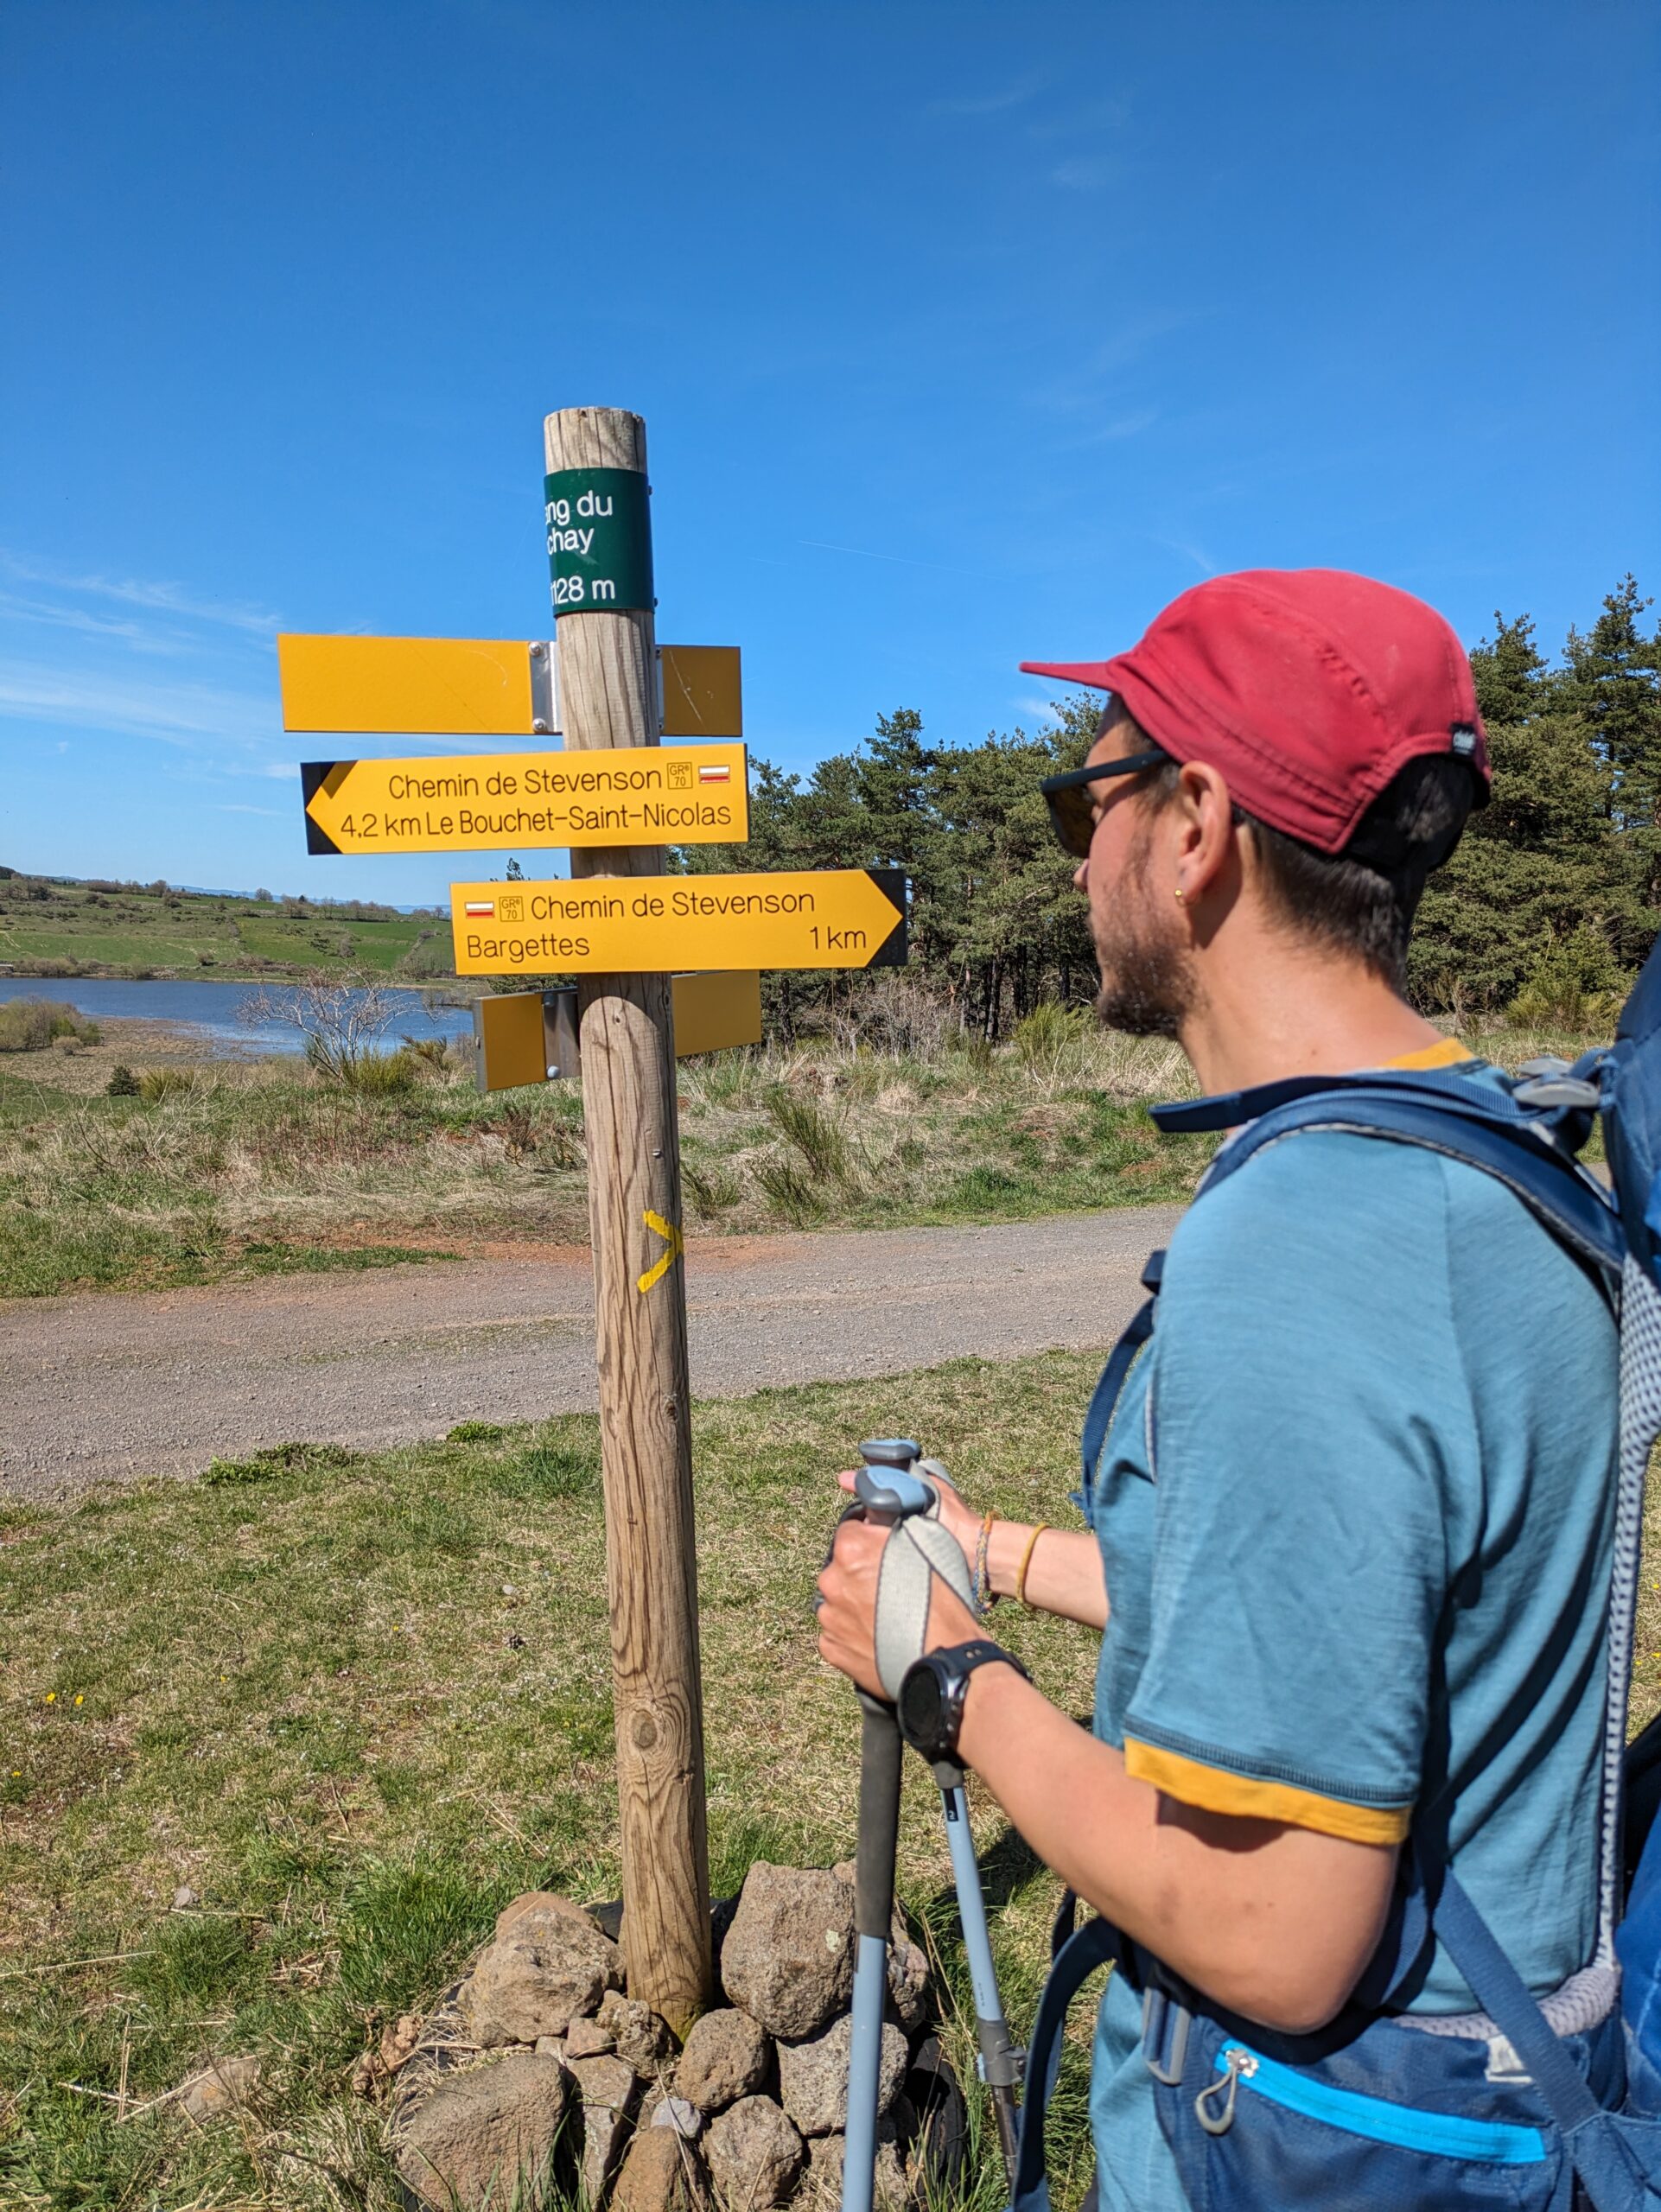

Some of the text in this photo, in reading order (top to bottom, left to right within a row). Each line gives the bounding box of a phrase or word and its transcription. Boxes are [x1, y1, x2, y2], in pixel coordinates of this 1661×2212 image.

[576, 490, 613, 517] du
[546, 527, 595, 556] chay
[591, 579, 615, 600] m
[388, 769, 662, 800] Chemin de Stevenson
[674, 776, 686, 787] 70
[340, 801, 732, 839] 4,2 km Le Bouchet-Saint-Nicolas
[506, 909, 518, 919] 70
[531, 891, 815, 920] Chemin de Stevenson
[467, 925, 867, 964] Bargettes 1 km
